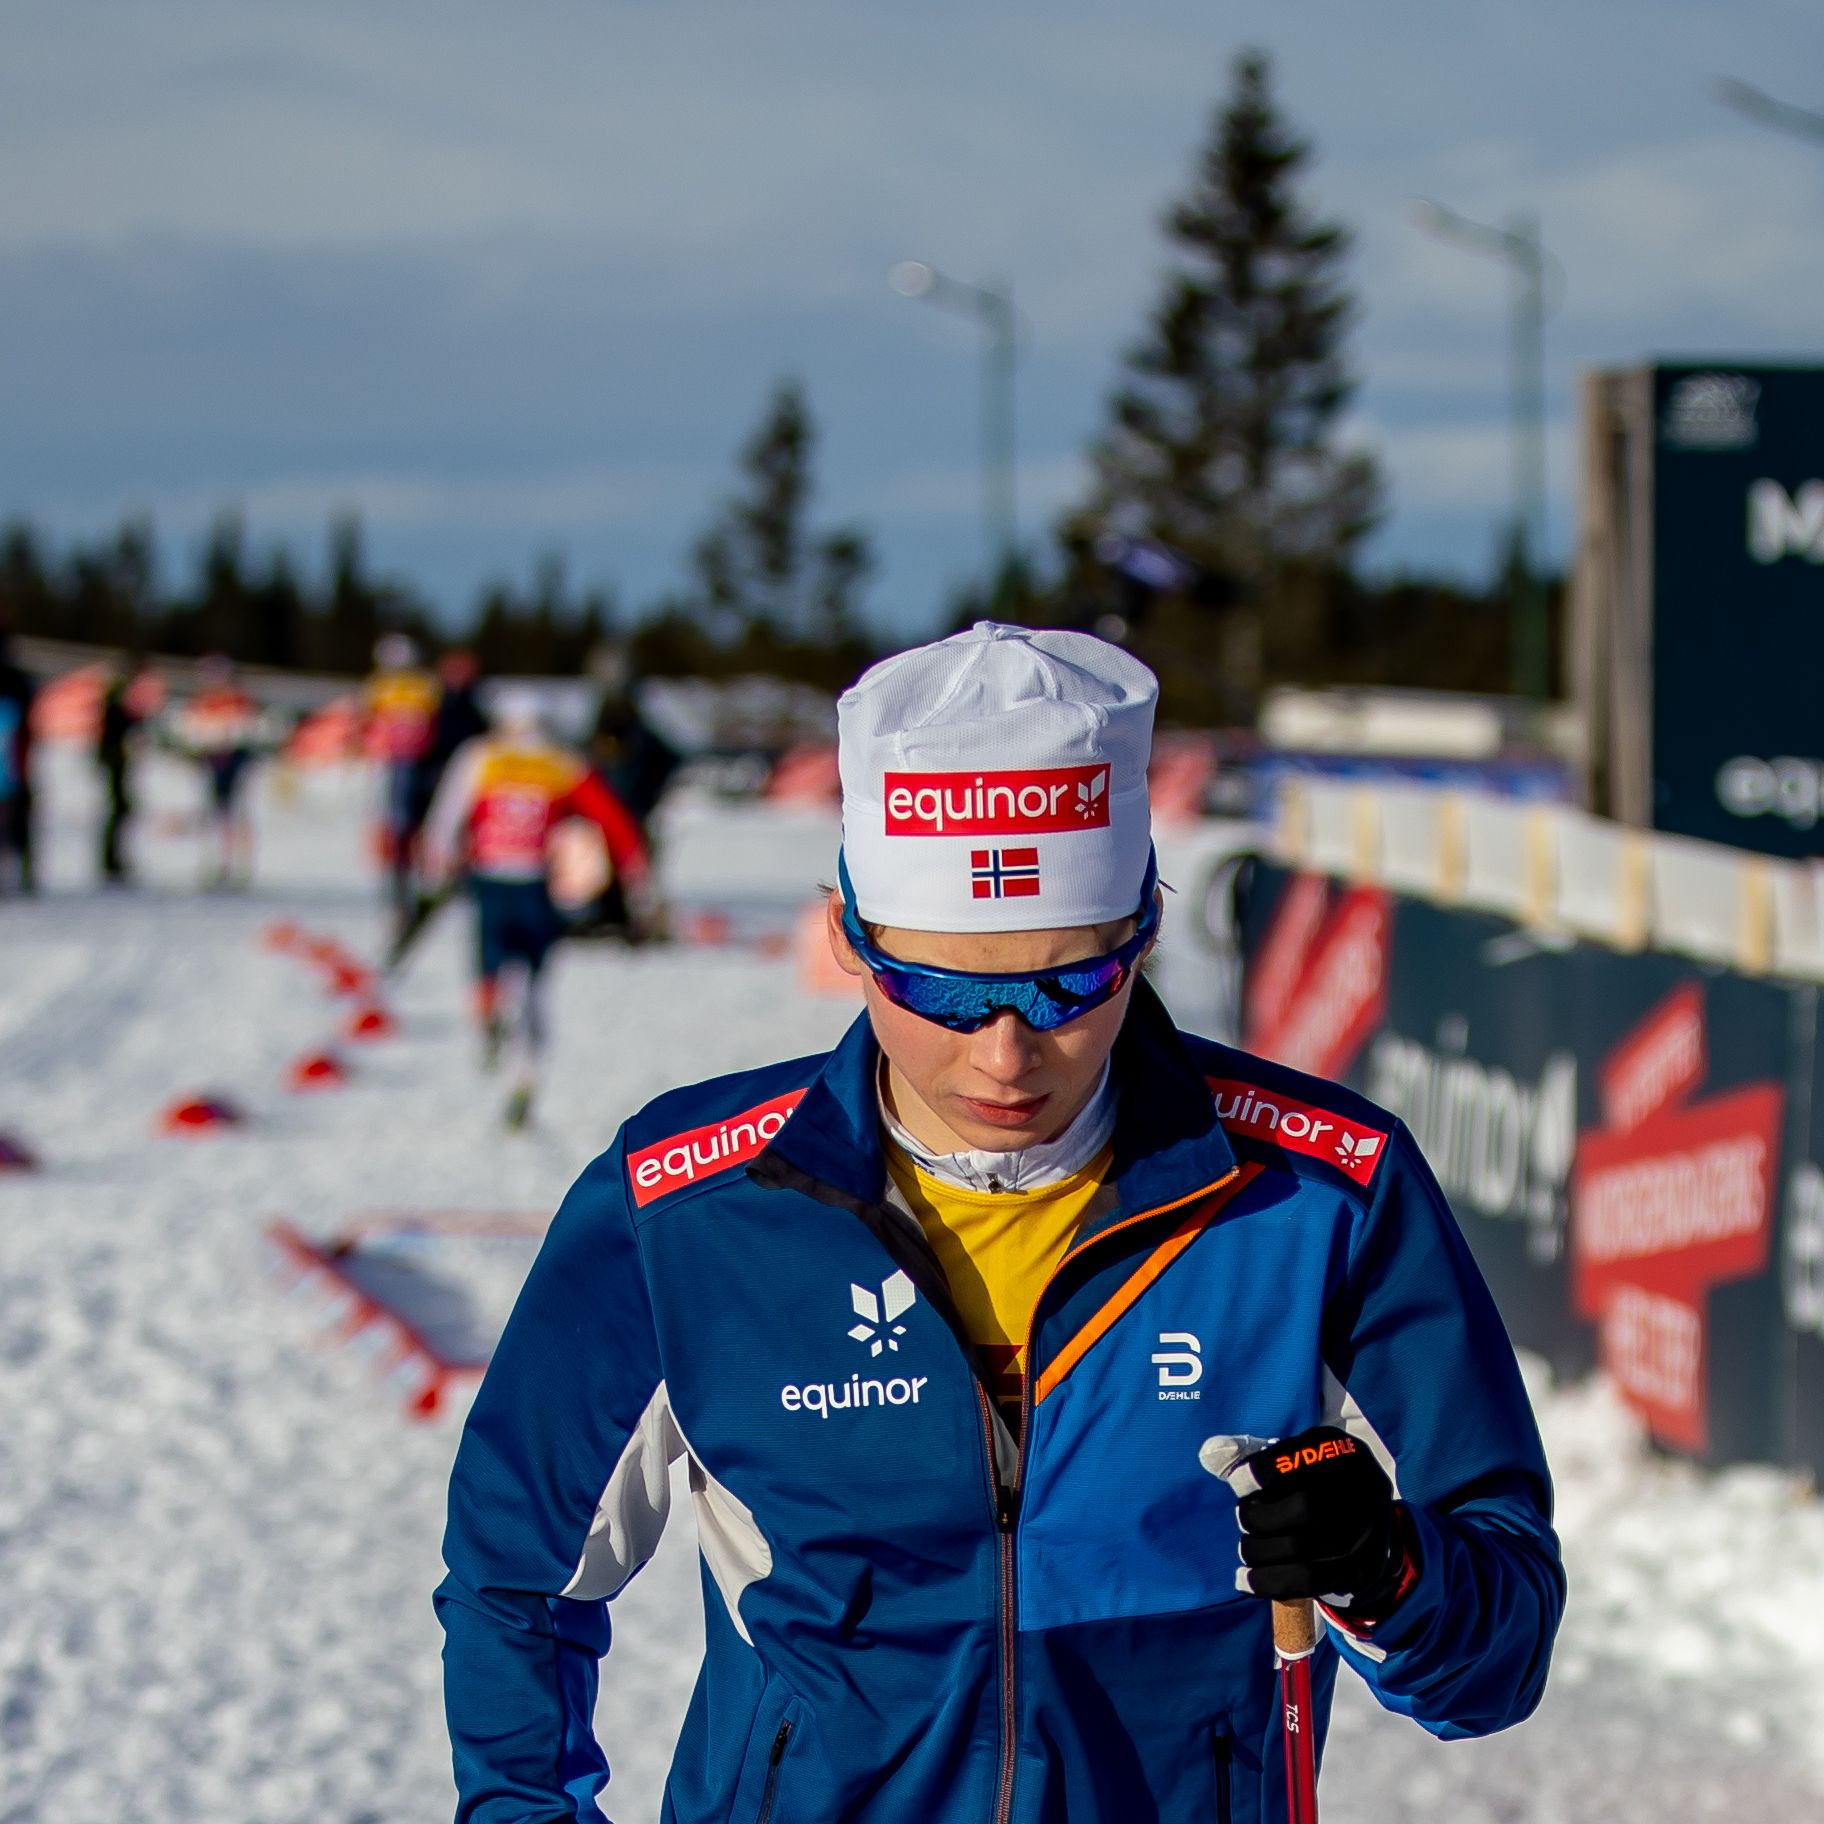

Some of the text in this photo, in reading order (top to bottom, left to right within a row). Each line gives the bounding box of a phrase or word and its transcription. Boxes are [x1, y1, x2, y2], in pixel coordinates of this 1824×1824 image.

[888, 776, 1069, 832] equinor
[1213, 1089, 1334, 1143] uinor
[780, 1373, 928, 1419] equinor
[1158, 1390, 1201, 1401] DÆHLIE
[1285, 1702, 1300, 1735] TCS
